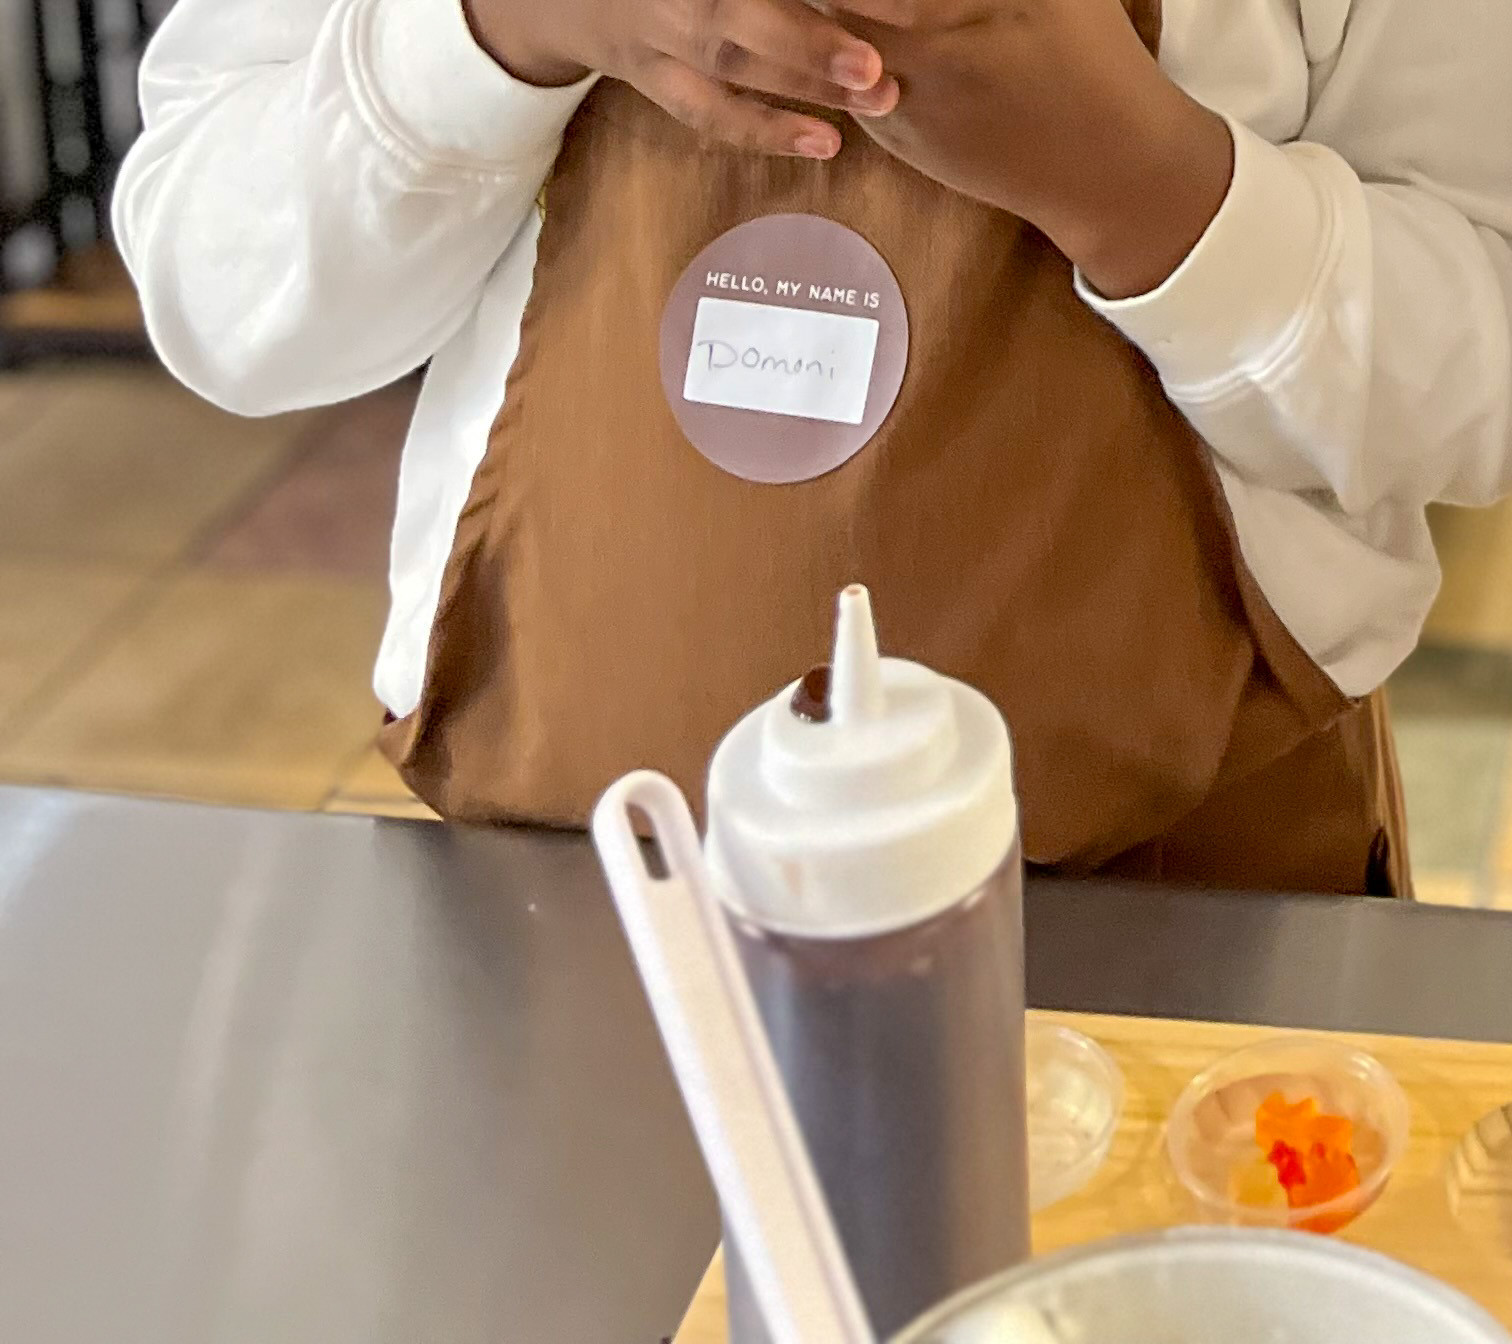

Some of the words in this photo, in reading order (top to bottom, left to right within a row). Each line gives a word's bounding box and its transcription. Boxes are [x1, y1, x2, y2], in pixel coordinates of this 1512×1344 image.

[705, 271, 769, 295] HELLO,
[776, 279, 802, 297] MY
[808, 284, 857, 306] NAME
[863, 291, 880, 309] IS
